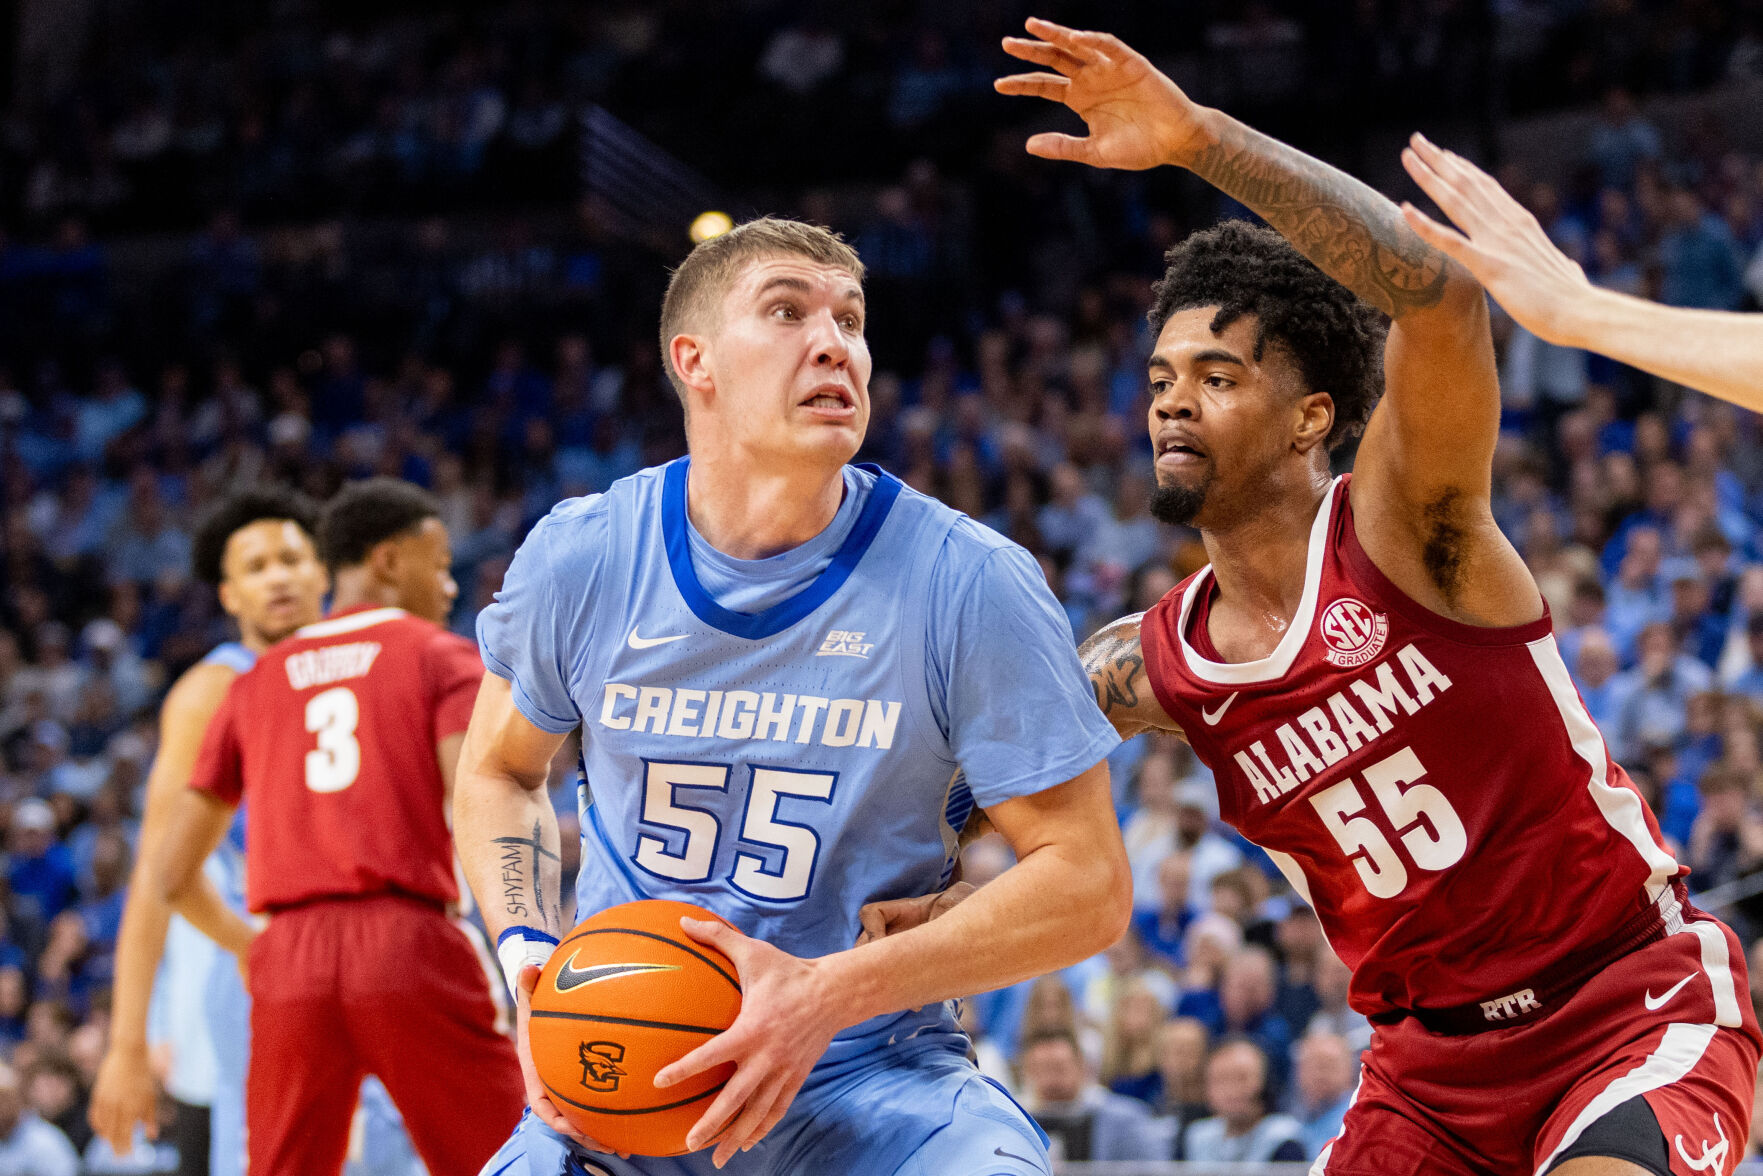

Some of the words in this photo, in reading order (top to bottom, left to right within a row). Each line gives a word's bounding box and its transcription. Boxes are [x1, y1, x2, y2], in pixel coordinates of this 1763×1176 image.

[820, 641, 875, 655] EAST
[826, 630, 867, 642] BIG
[1324, 602, 1372, 650] SEC
[1338, 628, 1386, 667] GRADUATE
[305, 687, 361, 793] 3
[599, 683, 903, 750] CREIGHTON
[1233, 643, 1453, 805] ALABAMA
[629, 756, 841, 904] 55
[1308, 745, 1468, 899] 55
[500, 844, 528, 918] SHYFAM
[1479, 988, 1543, 1021] RTR
